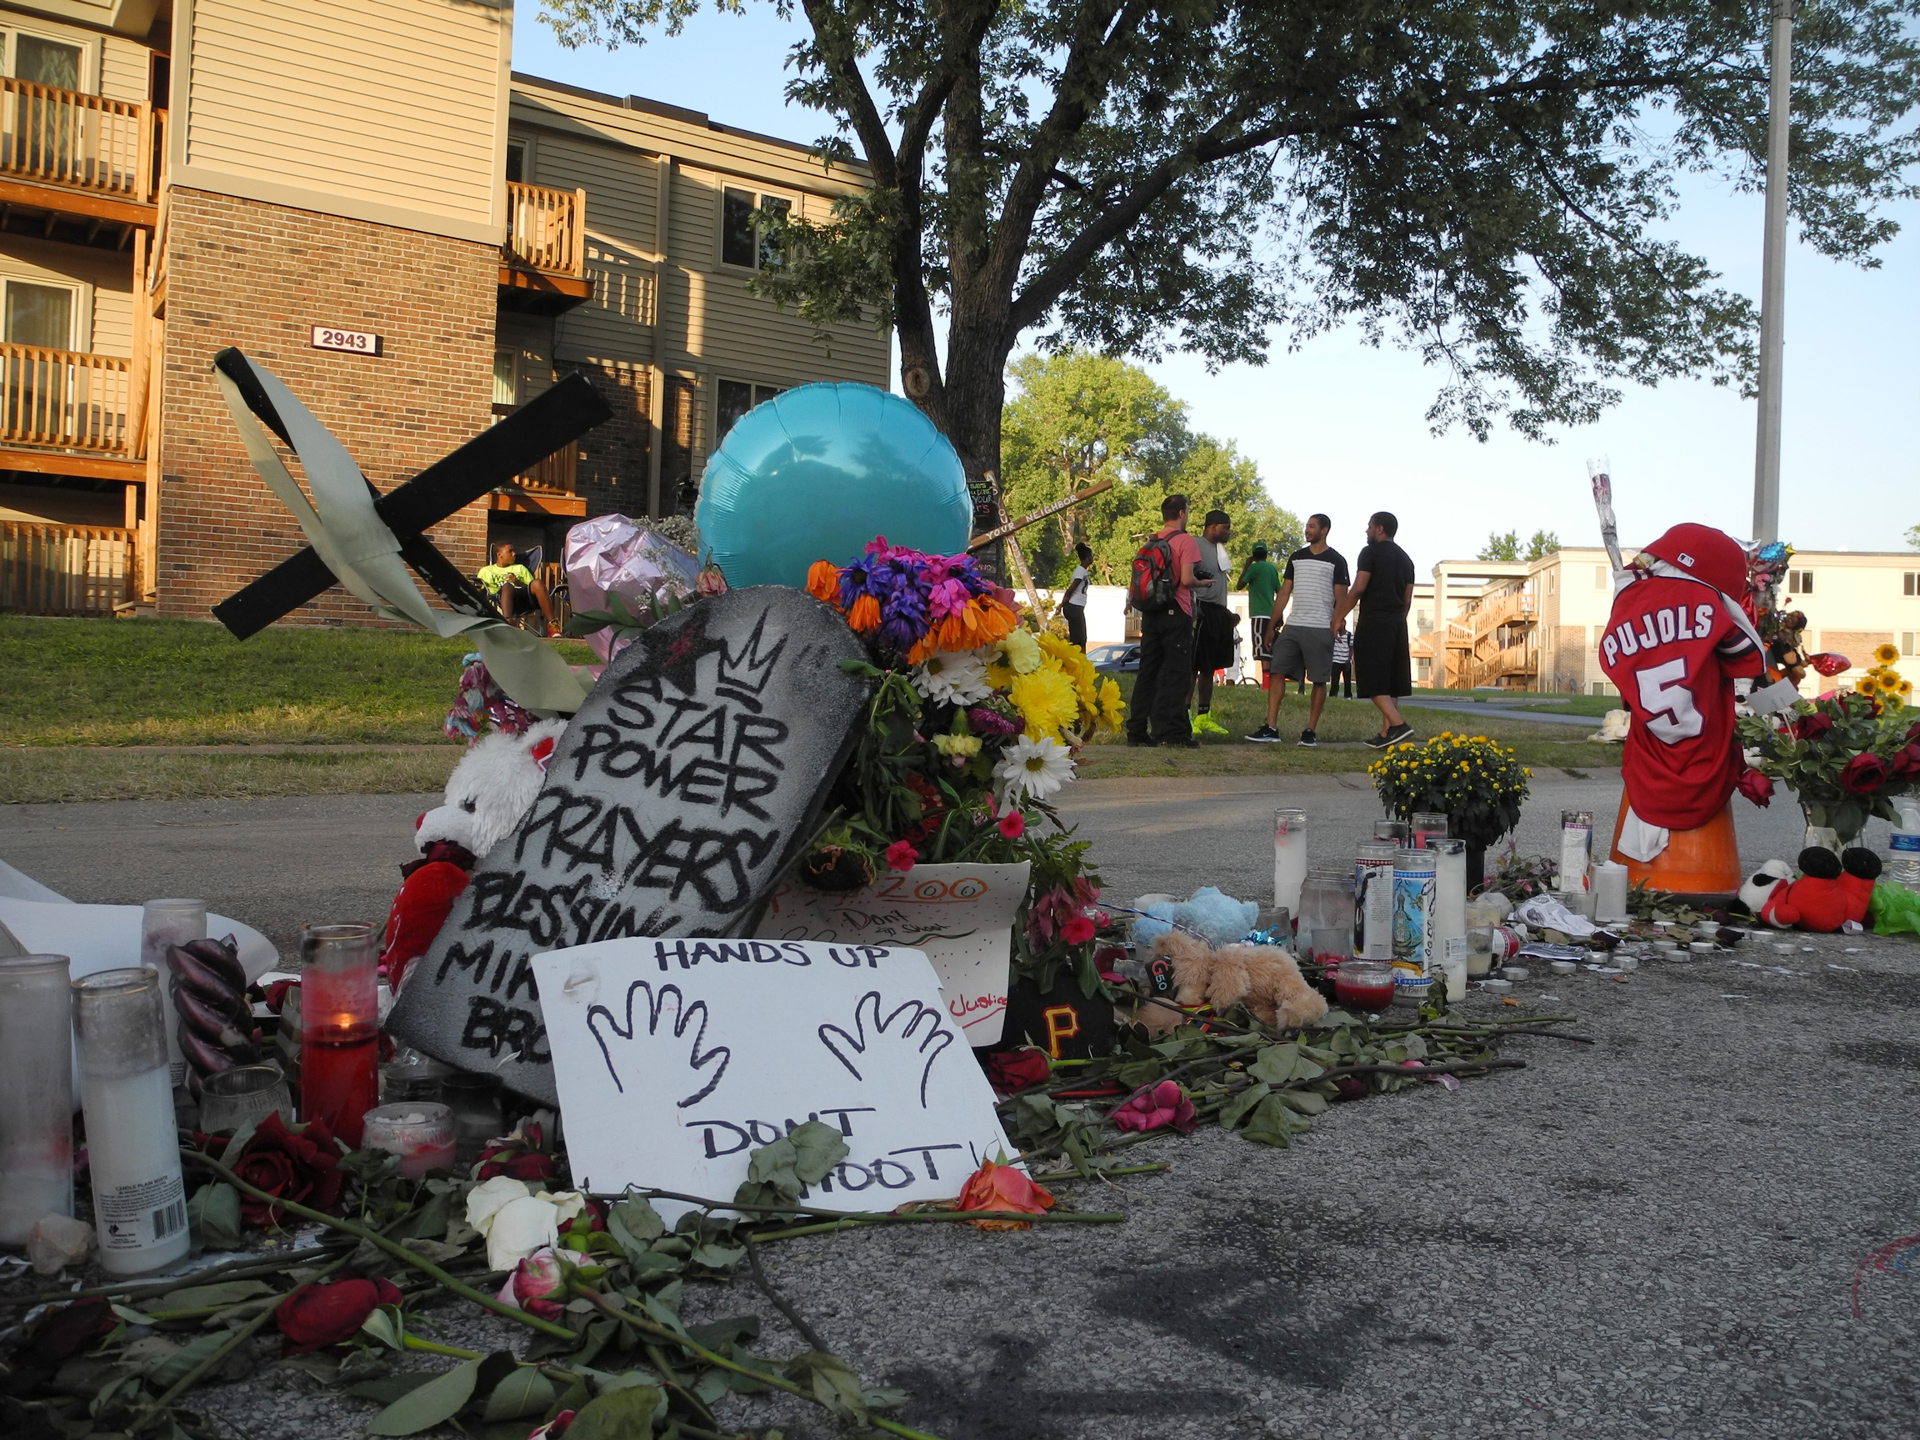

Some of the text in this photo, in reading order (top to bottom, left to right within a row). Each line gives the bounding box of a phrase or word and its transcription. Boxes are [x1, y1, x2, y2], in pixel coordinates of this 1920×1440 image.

[322, 330, 367, 349] 2943
[986, 494, 1079, 540] YOUR NEIGHBOR
[1602, 603, 1714, 668] PUJOLS
[607, 676, 790, 771] STAR
[1634, 656, 1705, 744] 5
[571, 723, 784, 822] POWER
[513, 786, 780, 914] PRAYERS
[654, 940, 891, 971] HANDS UP
[1042, 1003, 1081, 1060] P
[137, 1180, 153, 1188] PLAIN
[154, 1175, 168, 1184] WHITE
